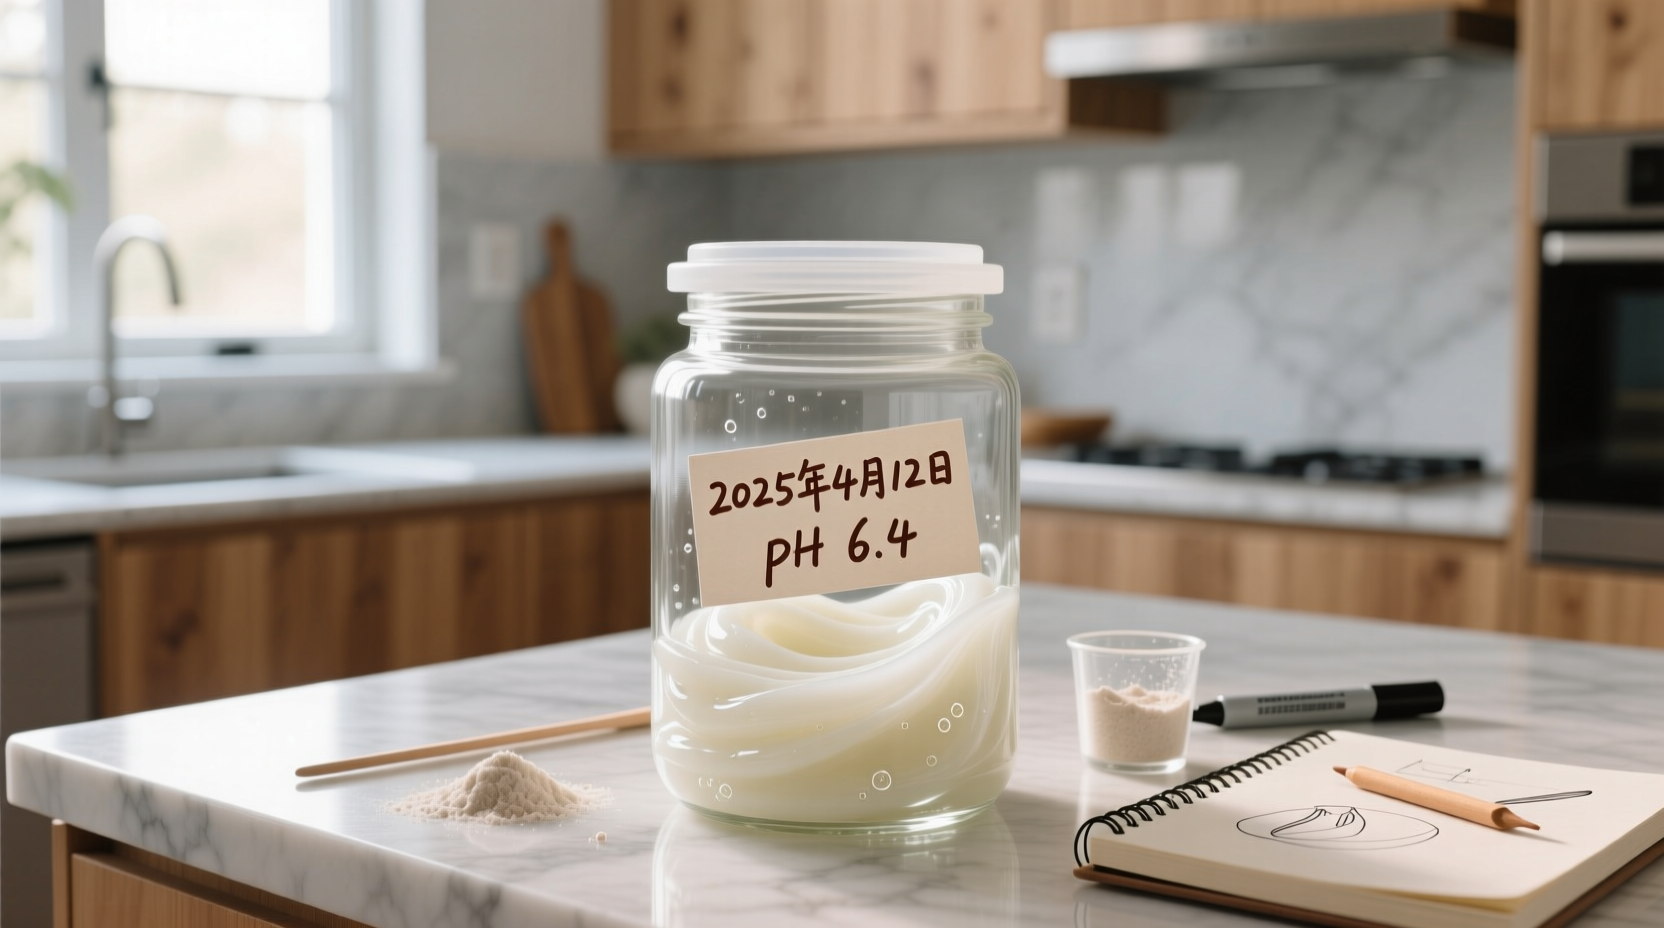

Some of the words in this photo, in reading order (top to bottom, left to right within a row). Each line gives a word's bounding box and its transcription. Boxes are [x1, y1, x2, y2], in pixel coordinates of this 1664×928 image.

[708, 450, 953, 516] 2025年4月12日
[847, 516, 918, 563] 6.4
